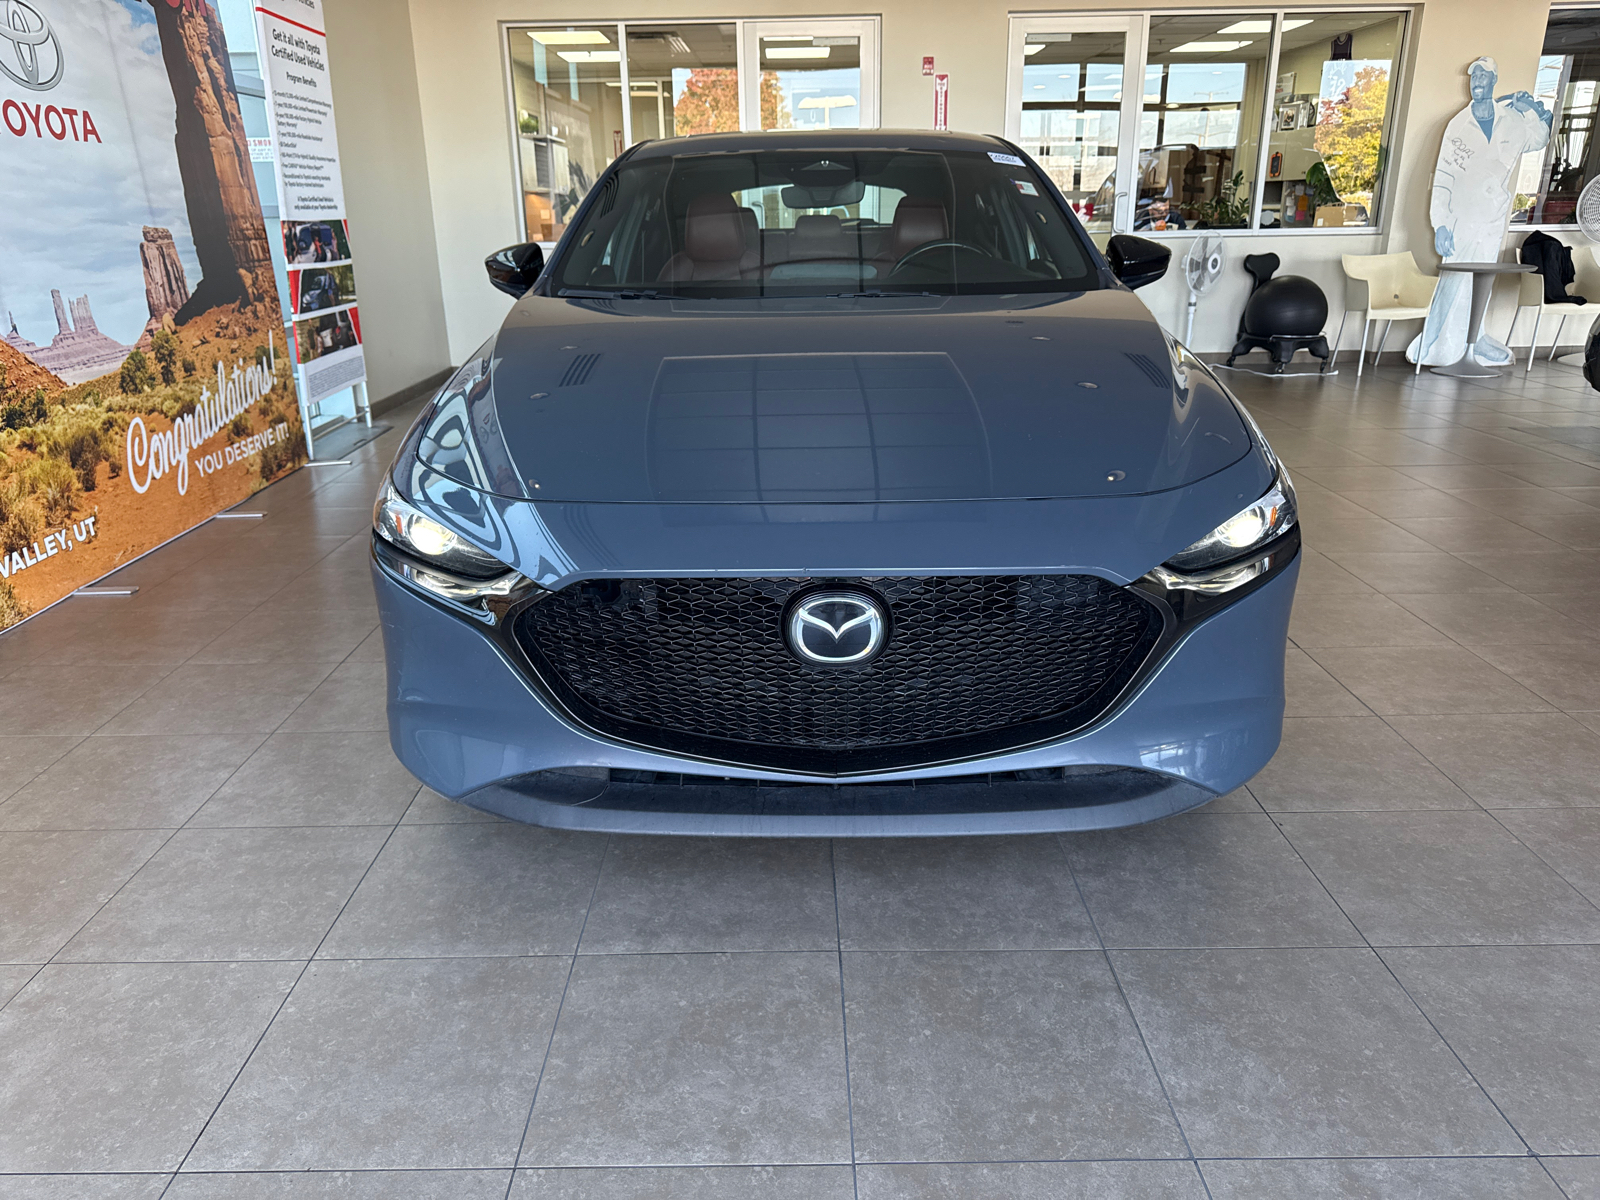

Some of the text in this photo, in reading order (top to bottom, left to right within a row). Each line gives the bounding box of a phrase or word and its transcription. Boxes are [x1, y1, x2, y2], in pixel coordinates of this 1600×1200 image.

[271, 45, 325, 71] Certified Used Vehicles
[272, 28, 282, 42] Get
[294, 37, 305, 50] with
[305, 40, 321, 55] Toyota
[286, 71, 317, 88] Program Benefits
[0, 99, 102, 143] OYOTA
[127, 329, 277, 496] Congratulations!
[195, 421, 290, 477] YOU DESERVE IT!
[0, 516, 95, 578] VALLEY, UT
